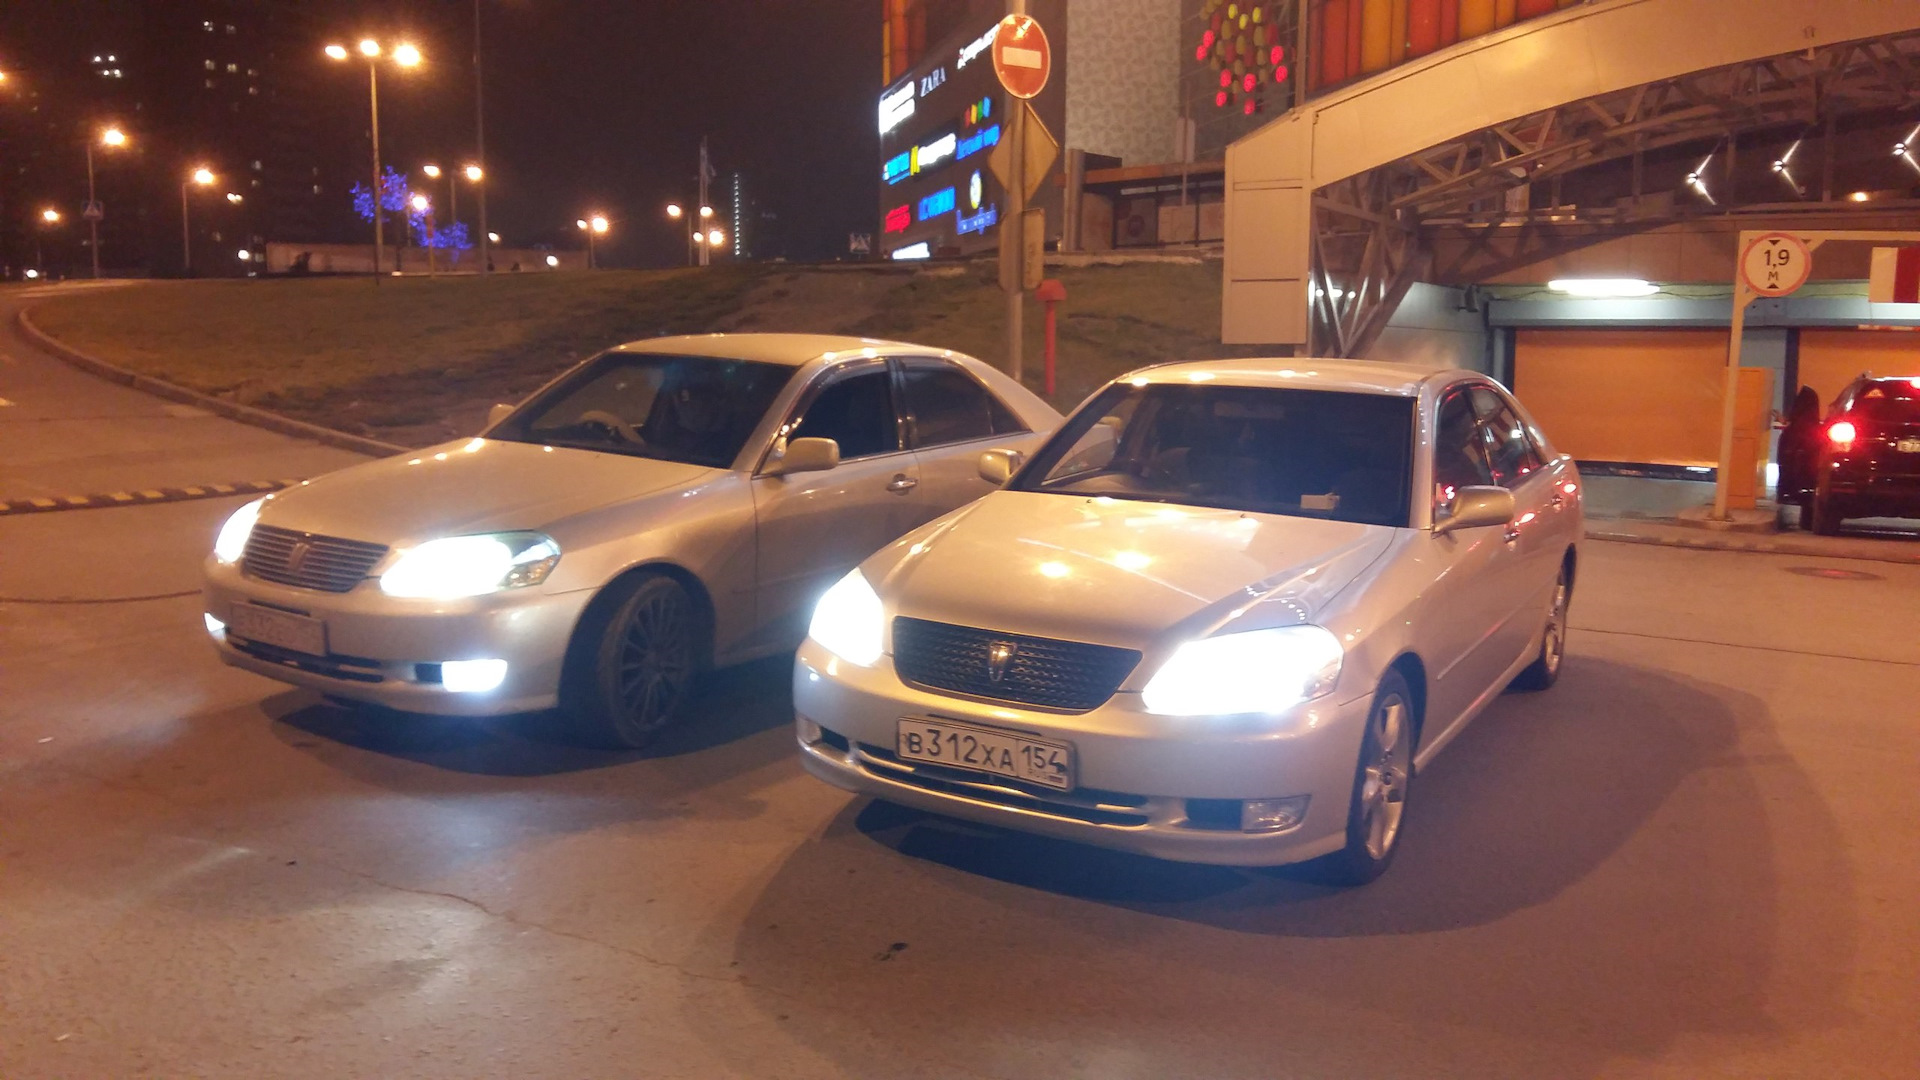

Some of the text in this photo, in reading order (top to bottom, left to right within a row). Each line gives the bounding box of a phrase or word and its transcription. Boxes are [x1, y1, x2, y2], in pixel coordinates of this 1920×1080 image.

[920, 67, 947, 98] ZARA
[1764, 249, 1790, 269] 1,9
[908, 728, 1067, 774] В312ХА 154
